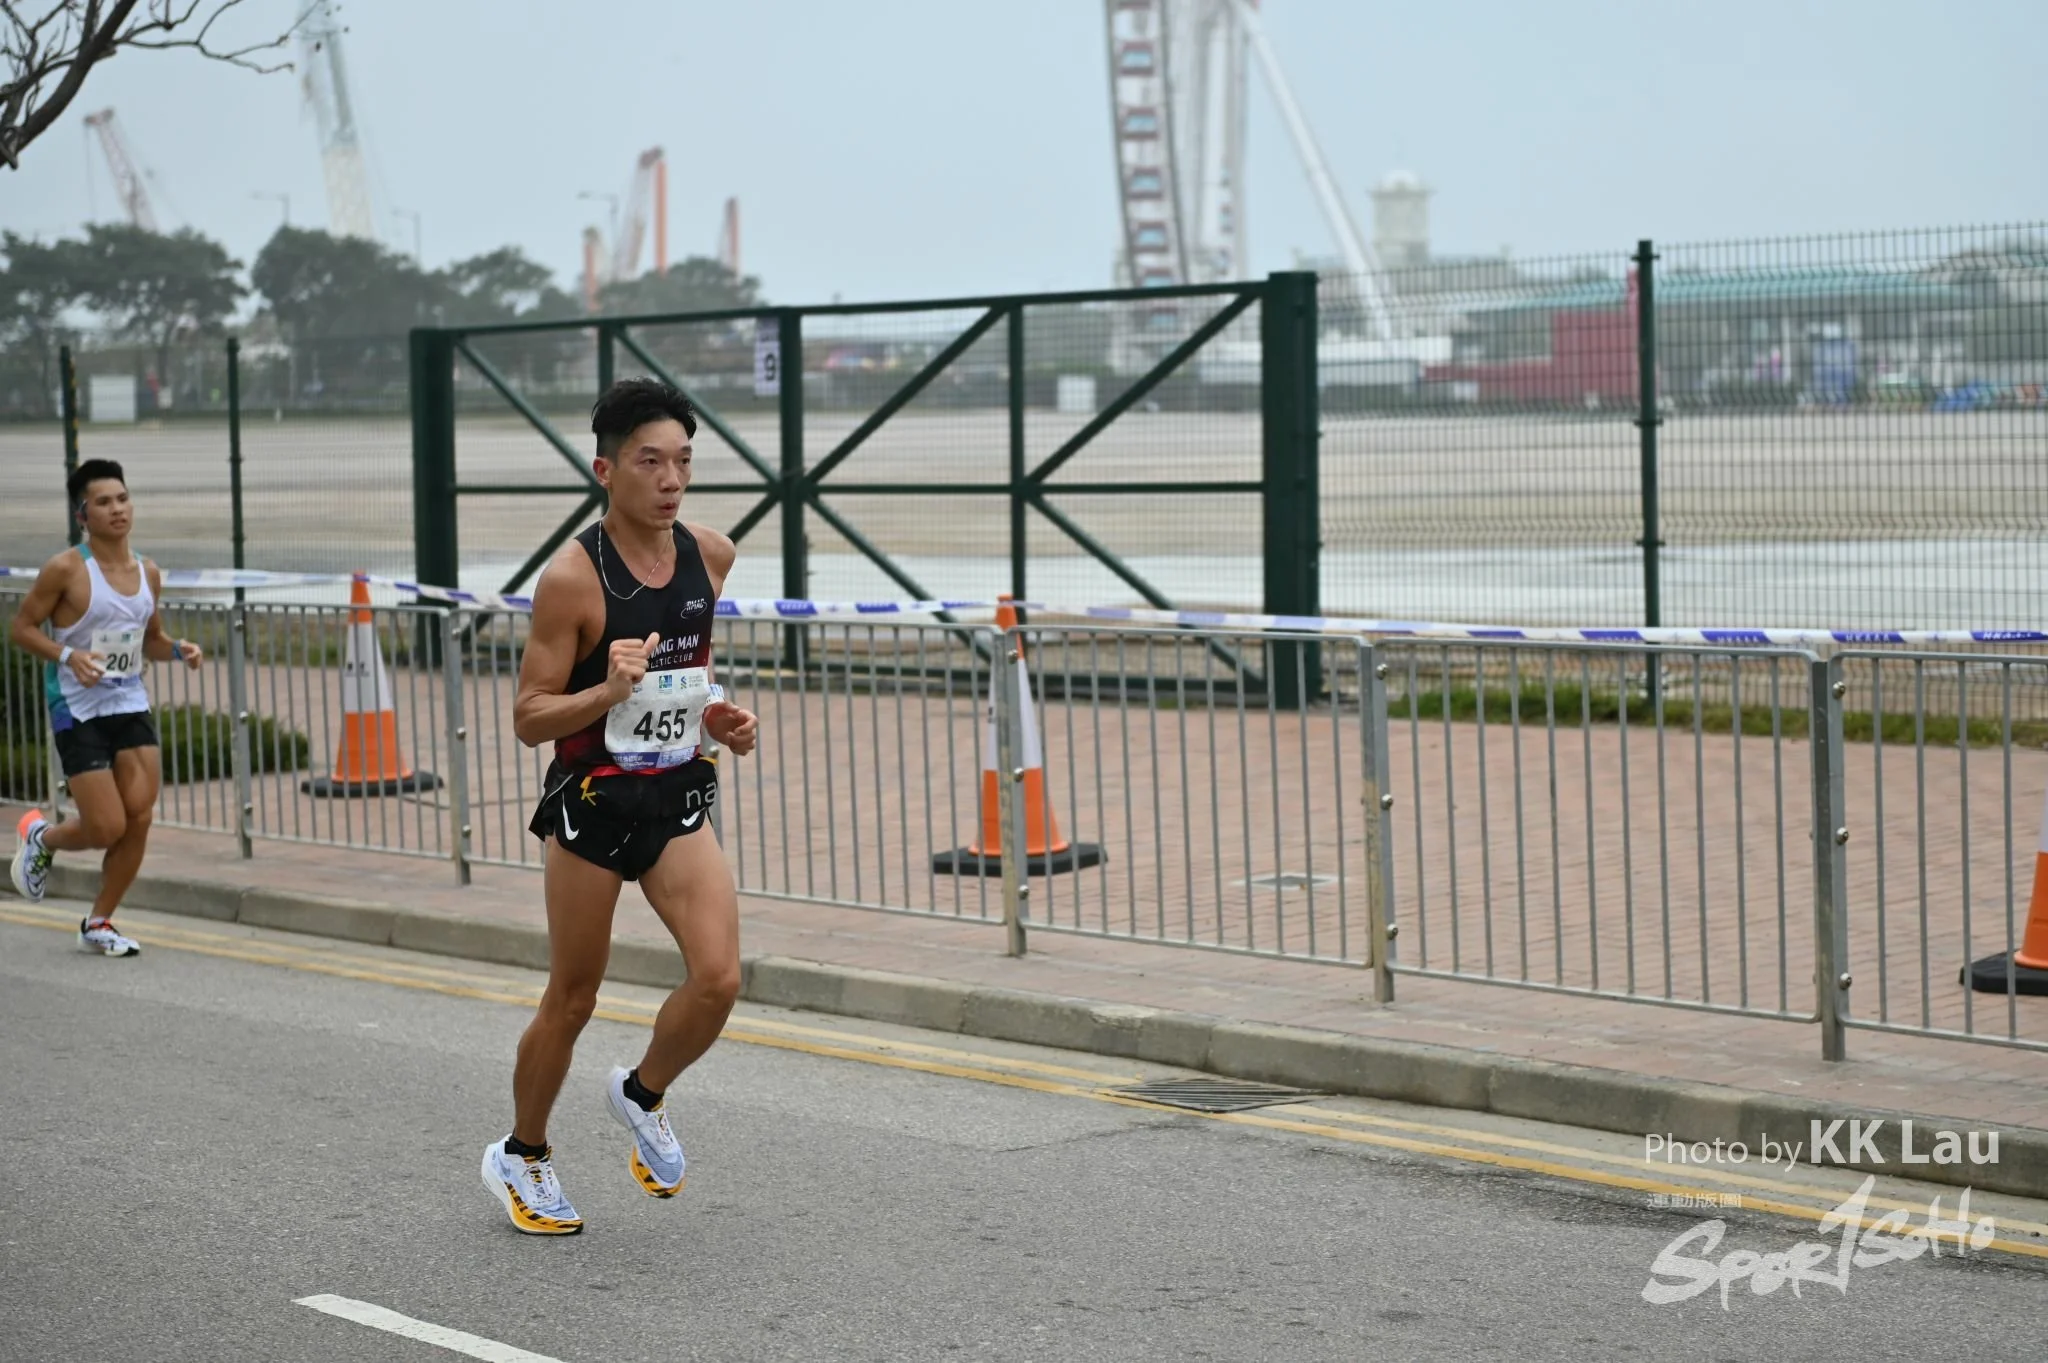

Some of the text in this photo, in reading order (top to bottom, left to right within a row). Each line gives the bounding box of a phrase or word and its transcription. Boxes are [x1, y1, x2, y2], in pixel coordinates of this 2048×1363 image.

[677, 633, 699, 650] MAN
[673, 652, 693, 664] CLUB
[633, 708, 688, 742] 455
